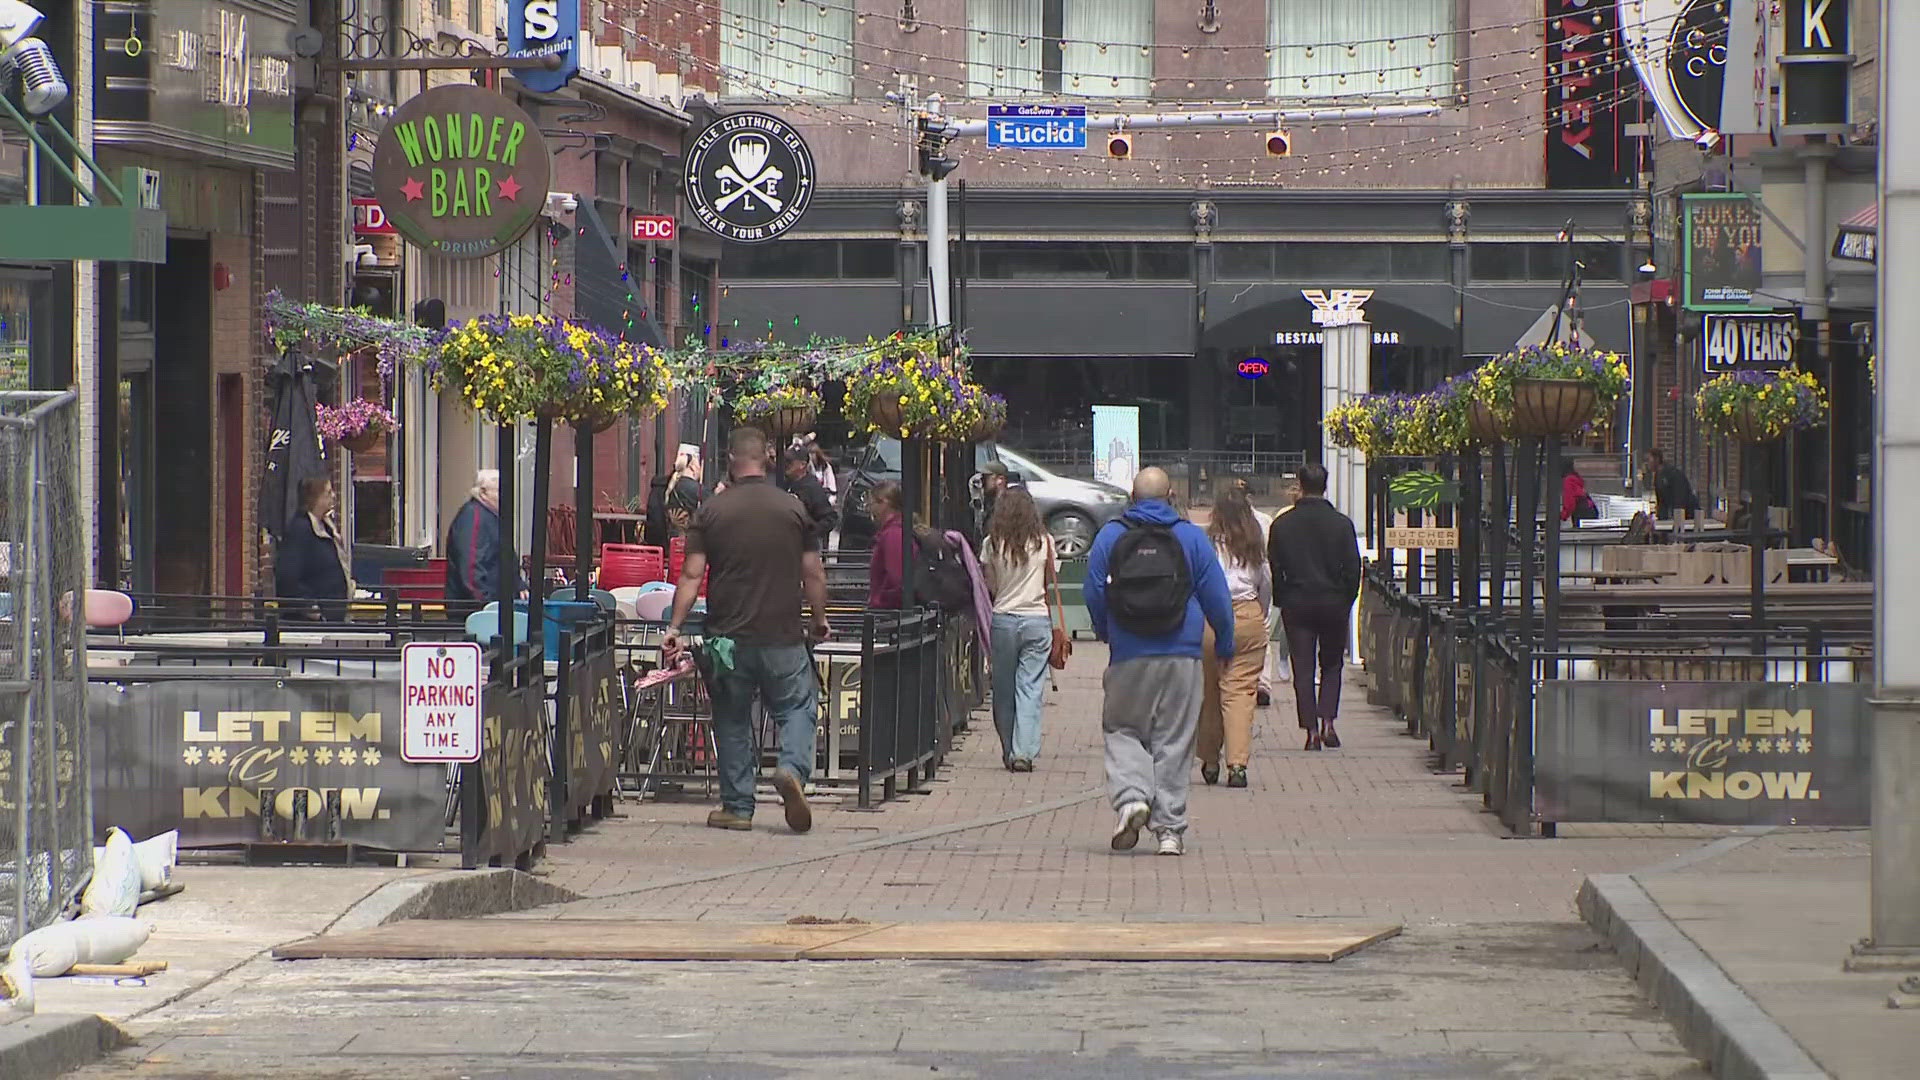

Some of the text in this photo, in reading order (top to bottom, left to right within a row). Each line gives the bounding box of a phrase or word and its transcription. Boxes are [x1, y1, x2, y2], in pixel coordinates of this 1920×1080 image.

[1803, 0, 1833, 48] K
[394, 112, 526, 168] WONDER
[698, 116, 801, 153] CLE CLOTHING CO.
[1000, 121, 1074, 143] Euclid
[431, 167, 493, 217] BAR
[634, 220, 672, 237] FDC
[698, 204, 800, 239] WEAR YOUR PRIDE
[440, 239, 489, 253] DRINK
[1373, 332, 1400, 345] BAR
[1709, 320, 1793, 365] 40 YEARS
[1238, 362, 1269, 375] OPEN
[428, 657, 455, 679] NO
[408, 685, 474, 706] PARKING
[184, 711, 382, 742] LET EM
[427, 712, 456, 727] ANY
[1650, 709, 1812, 735] LET EM
[423, 732, 459, 747] TIME
[1650, 771, 1820, 799] KNOW.
